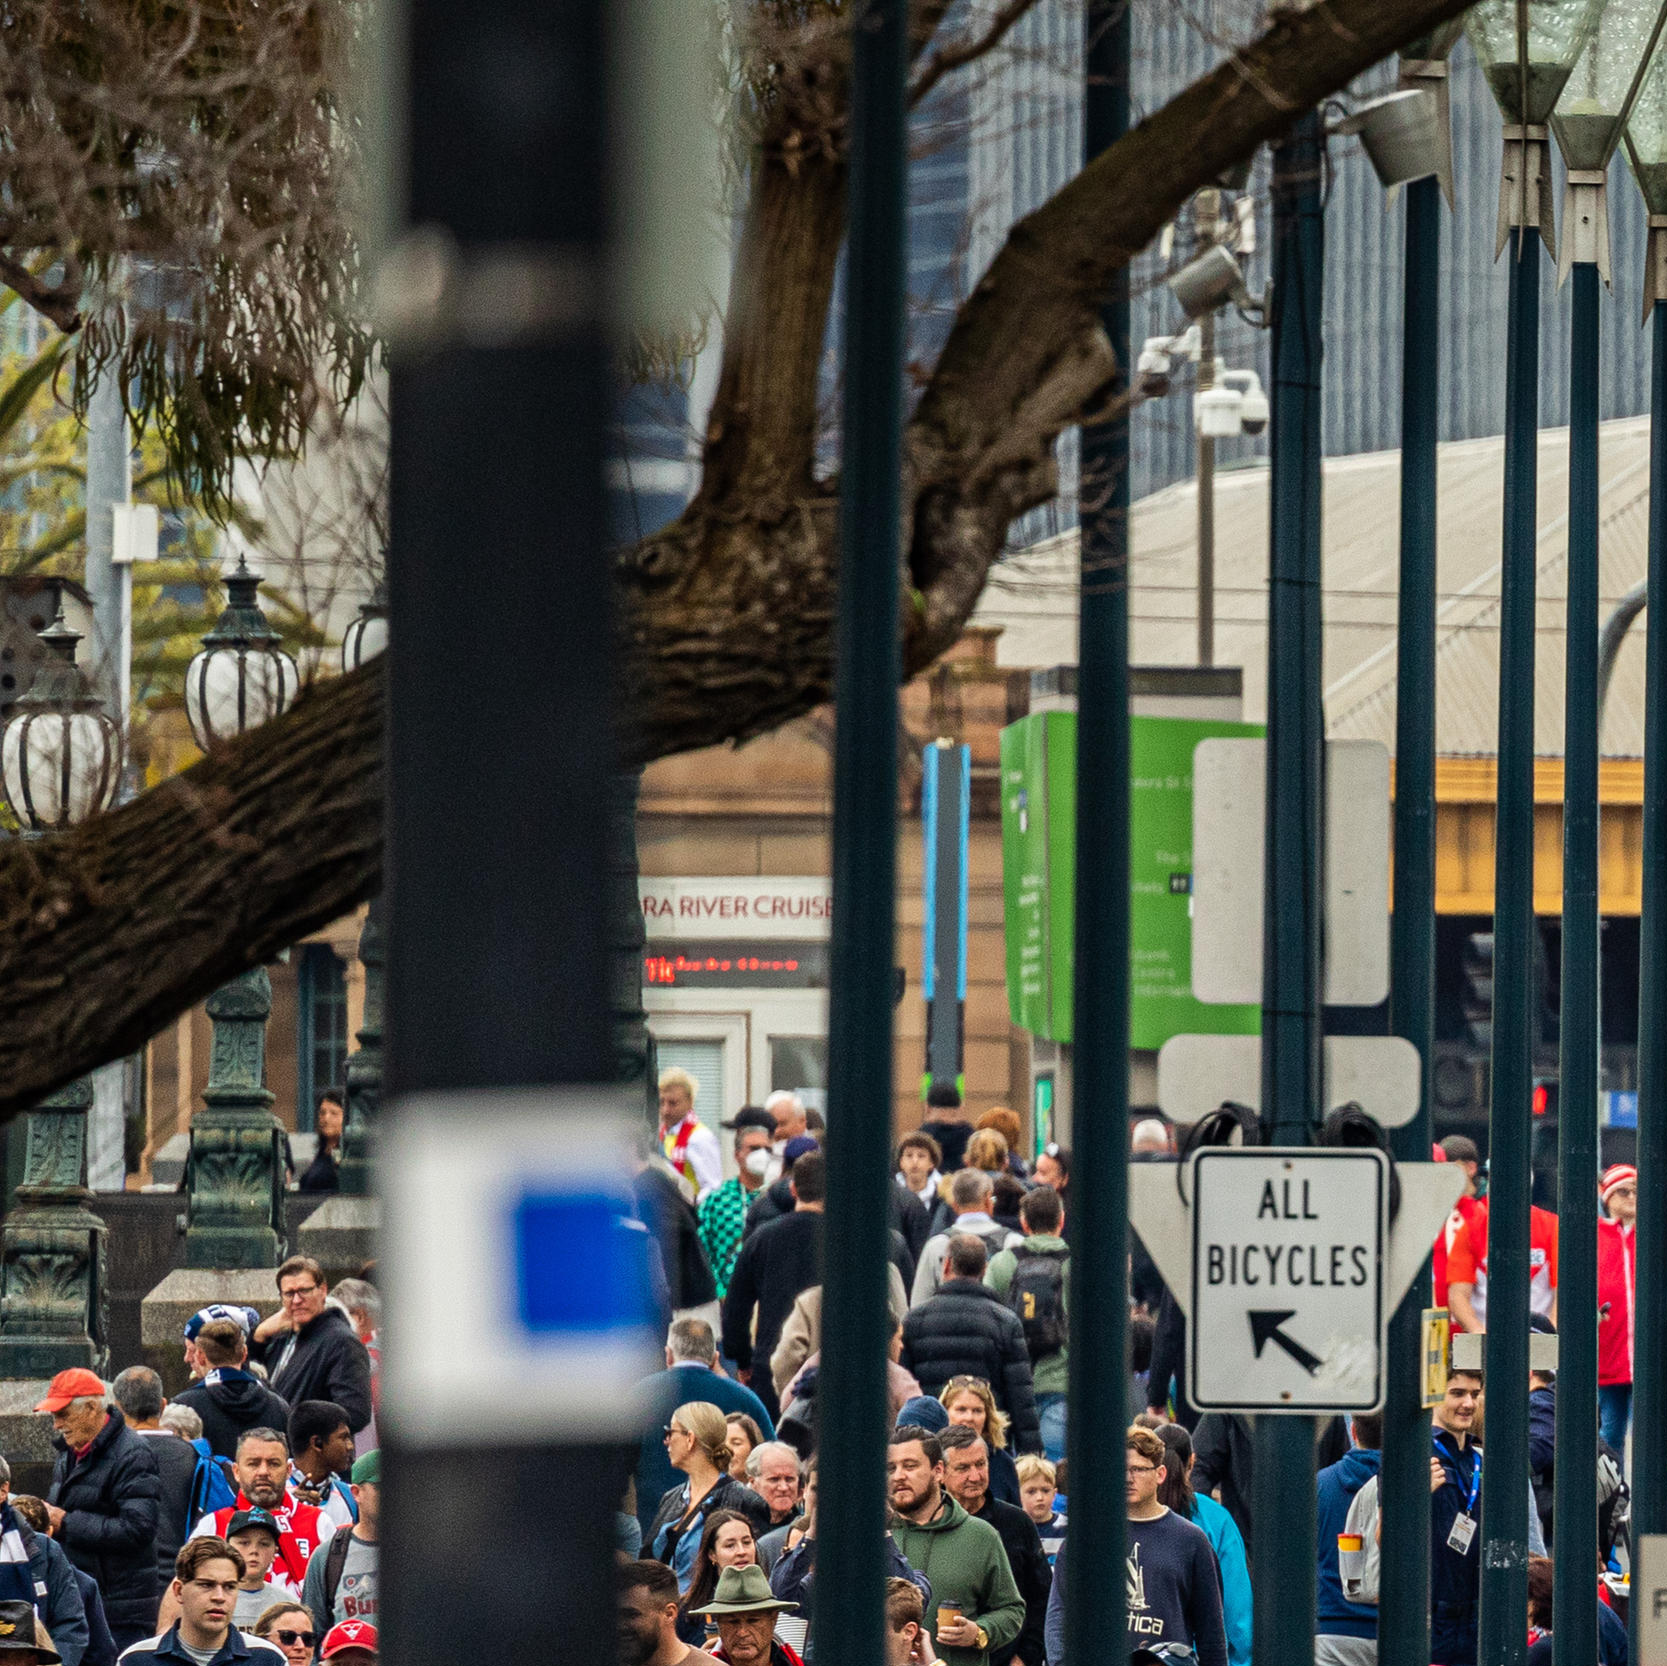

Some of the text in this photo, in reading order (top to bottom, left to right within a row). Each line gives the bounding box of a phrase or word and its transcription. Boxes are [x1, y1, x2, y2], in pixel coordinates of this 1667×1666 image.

[643, 897, 674, 917] RA
[680, 897, 748, 917] RIVER
[1258, 1179, 1318, 1219] ALL
[1208, 1244, 1367, 1286] BICYCLES
[1127, 1611, 1164, 1635] tica
